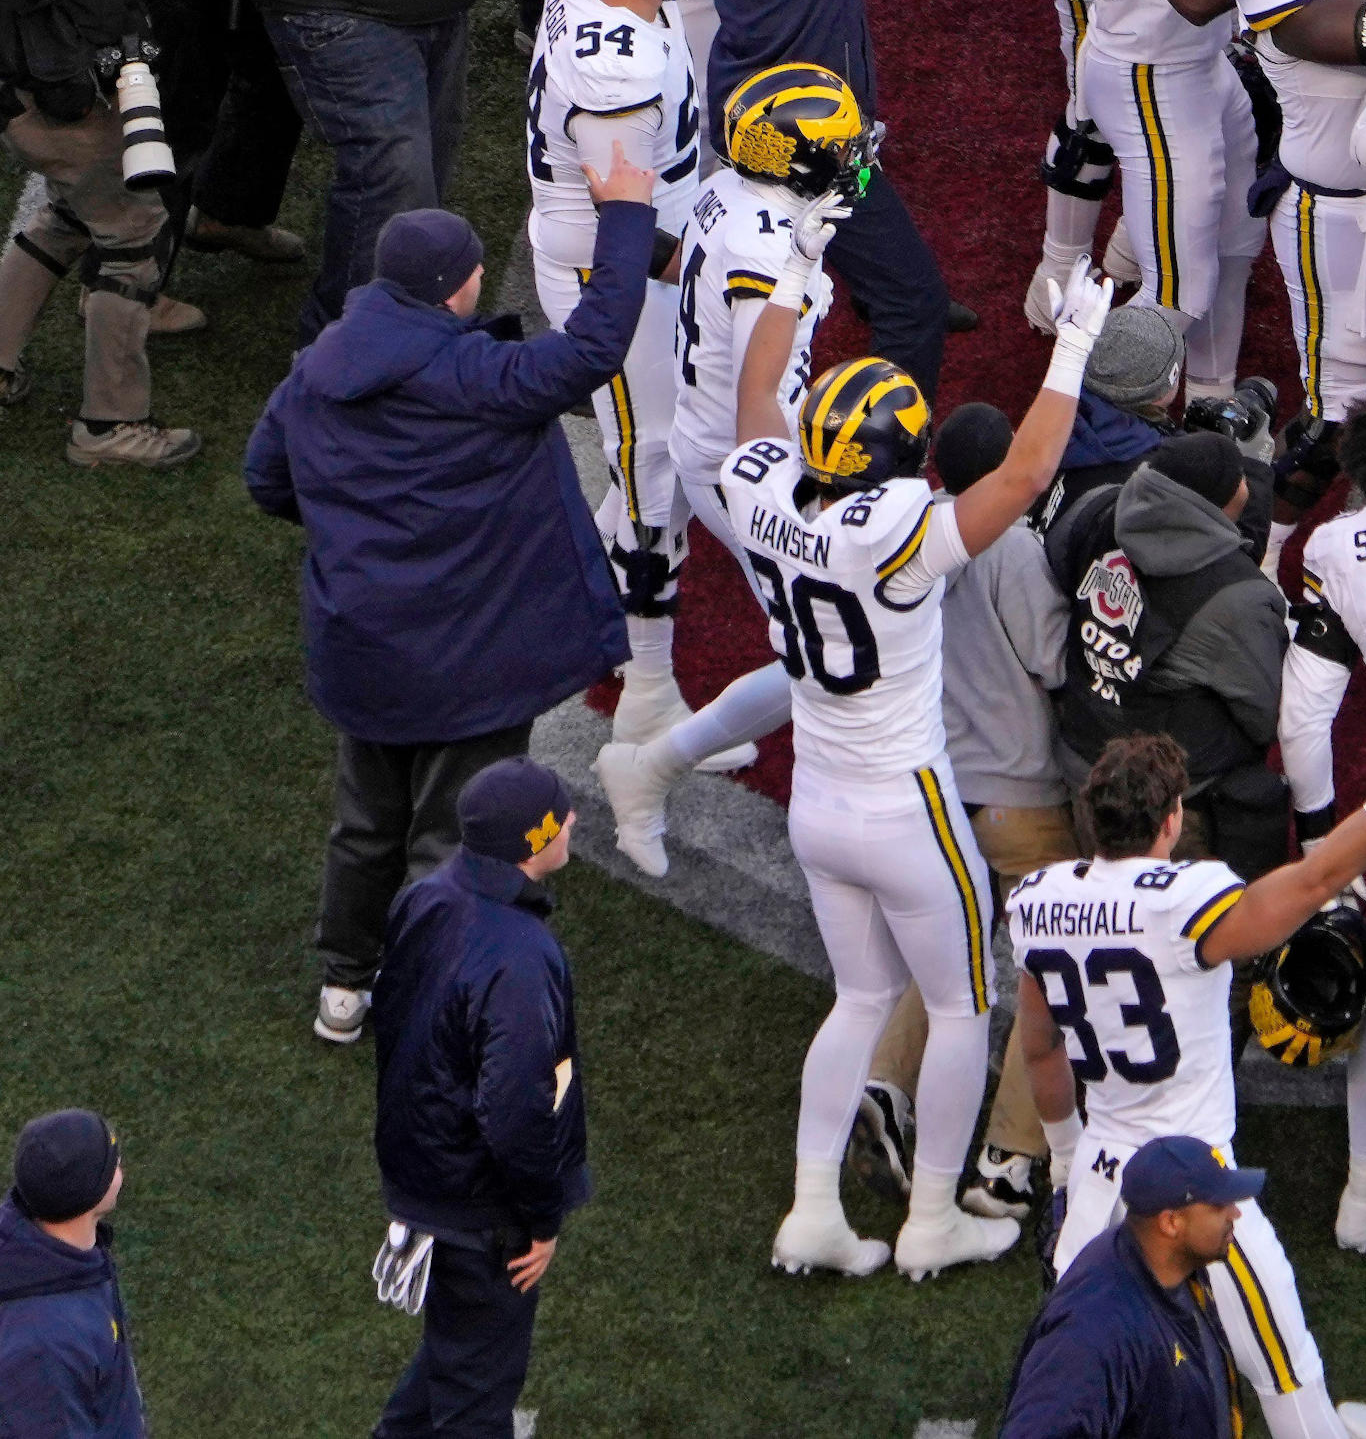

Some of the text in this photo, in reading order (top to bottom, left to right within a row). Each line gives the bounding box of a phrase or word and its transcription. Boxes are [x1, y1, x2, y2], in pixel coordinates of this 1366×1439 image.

[575, 21, 637, 59] 54
[750, 505, 832, 570] HANSEN
[743, 547, 882, 697] 80
[524, 810, 561, 855] M
[1018, 900, 1145, 939] MARSHALL
[1024, 947, 1183, 1086] 83
[1091, 1146, 1121, 1183] M
